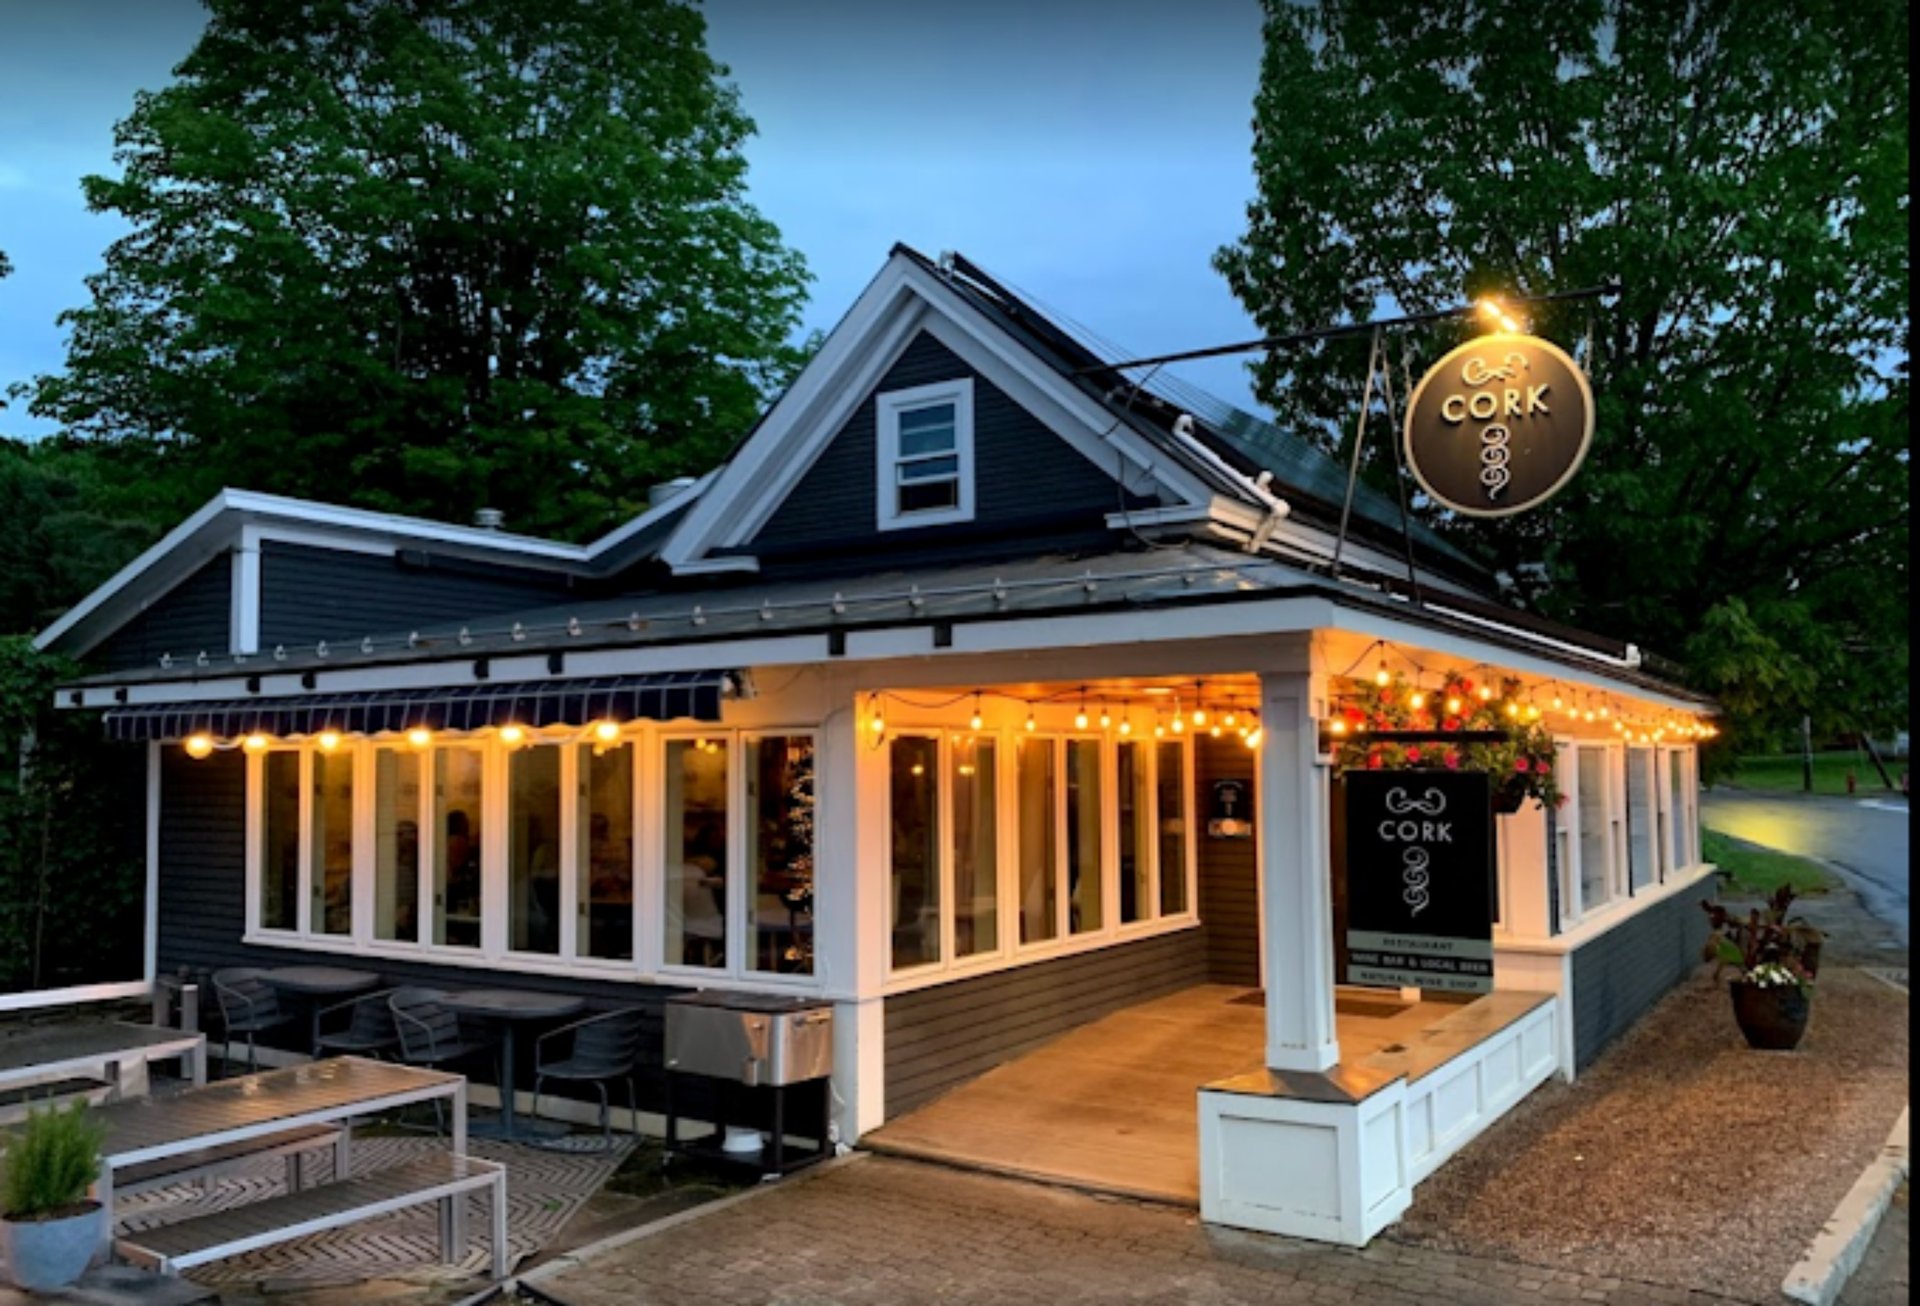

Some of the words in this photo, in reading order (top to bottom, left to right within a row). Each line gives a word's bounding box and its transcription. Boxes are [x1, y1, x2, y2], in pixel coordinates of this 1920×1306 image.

[1441, 383, 1551, 424] CORK
[1378, 820, 1453, 843] CORK
[1382, 938, 1454, 951] RESTAURANT
[1382, 955, 1406, 967] BAR
[1408, 957, 1418, 969] &
[1420, 959, 1457, 971] LOCAL
[1459, 961, 1489, 973] BEER
[1360, 971, 1410, 983] NATURAL
[1414, 976, 1443, 986] WINE
